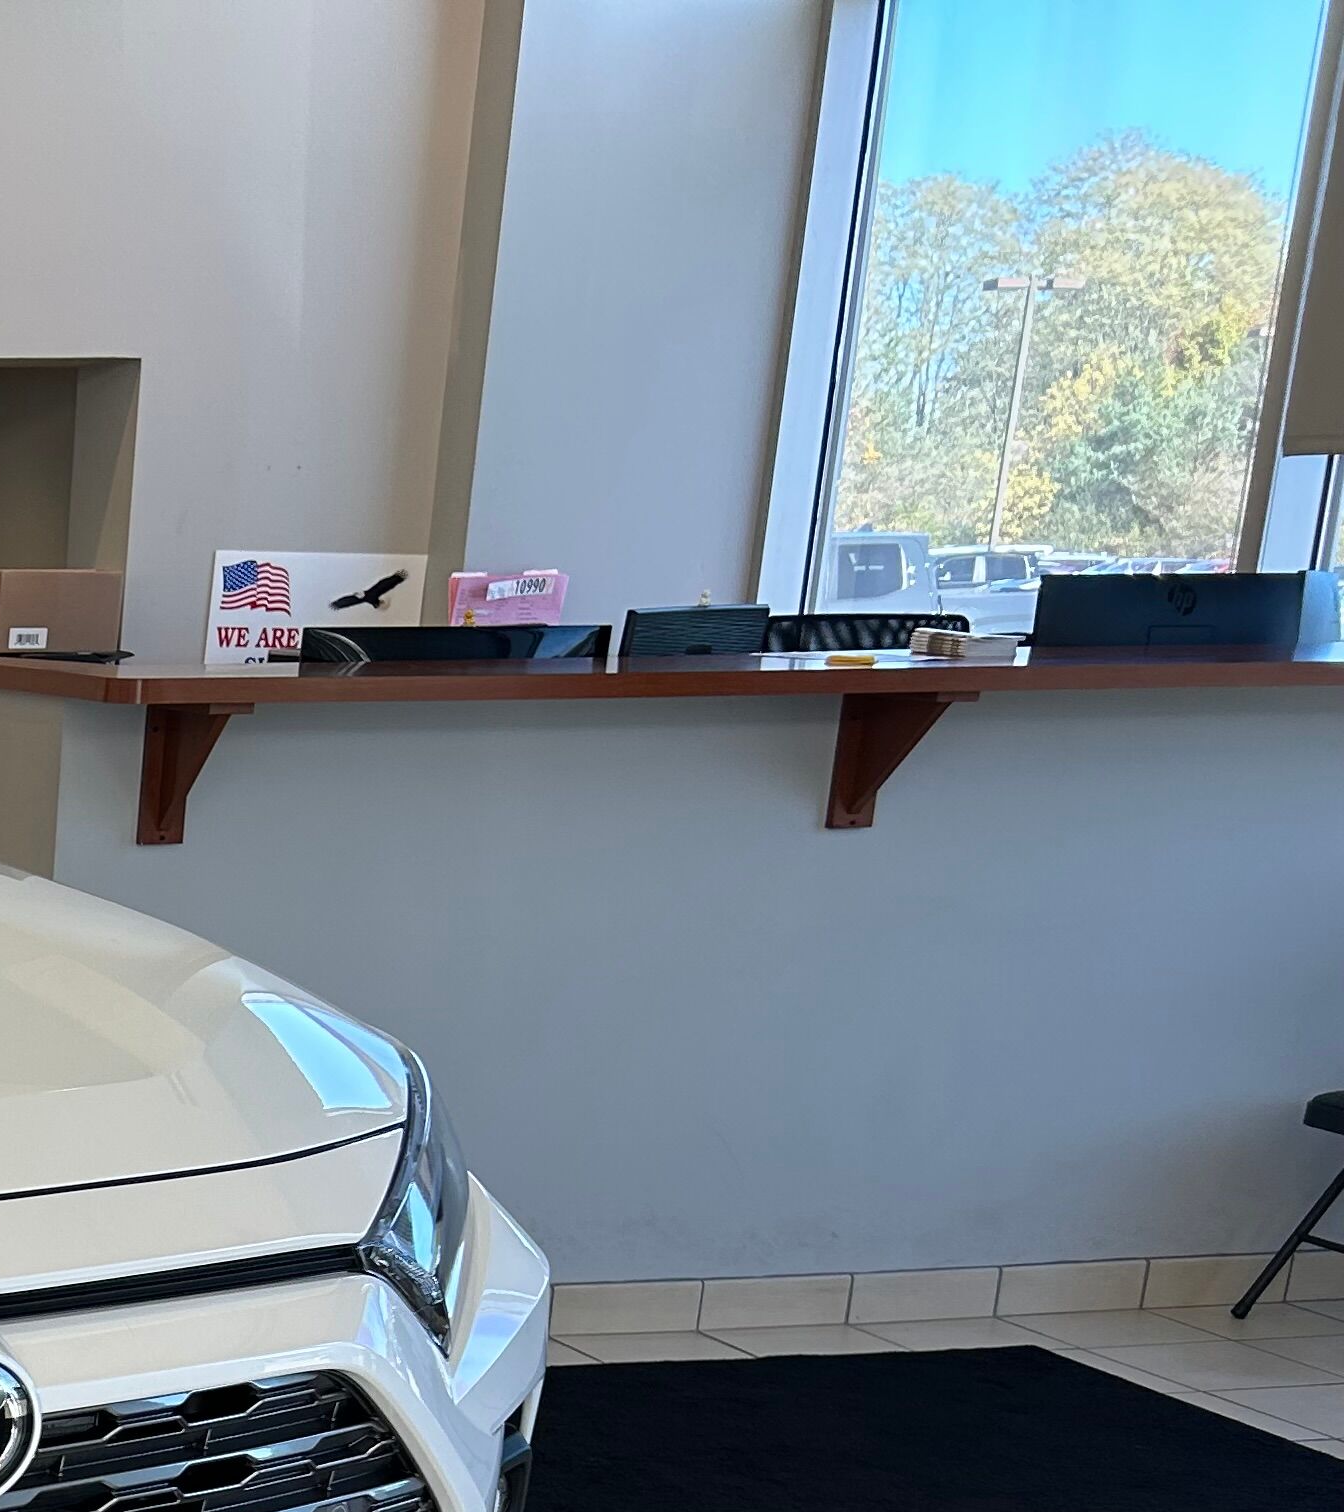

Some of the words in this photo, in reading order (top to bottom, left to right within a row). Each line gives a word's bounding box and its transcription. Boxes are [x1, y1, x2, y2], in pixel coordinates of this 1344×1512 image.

[515, 578, 546, 595] 10990
[1169, 584, 1196, 616] hp
[217, 626, 250, 648] WE
[255, 627, 300, 649] ARE
